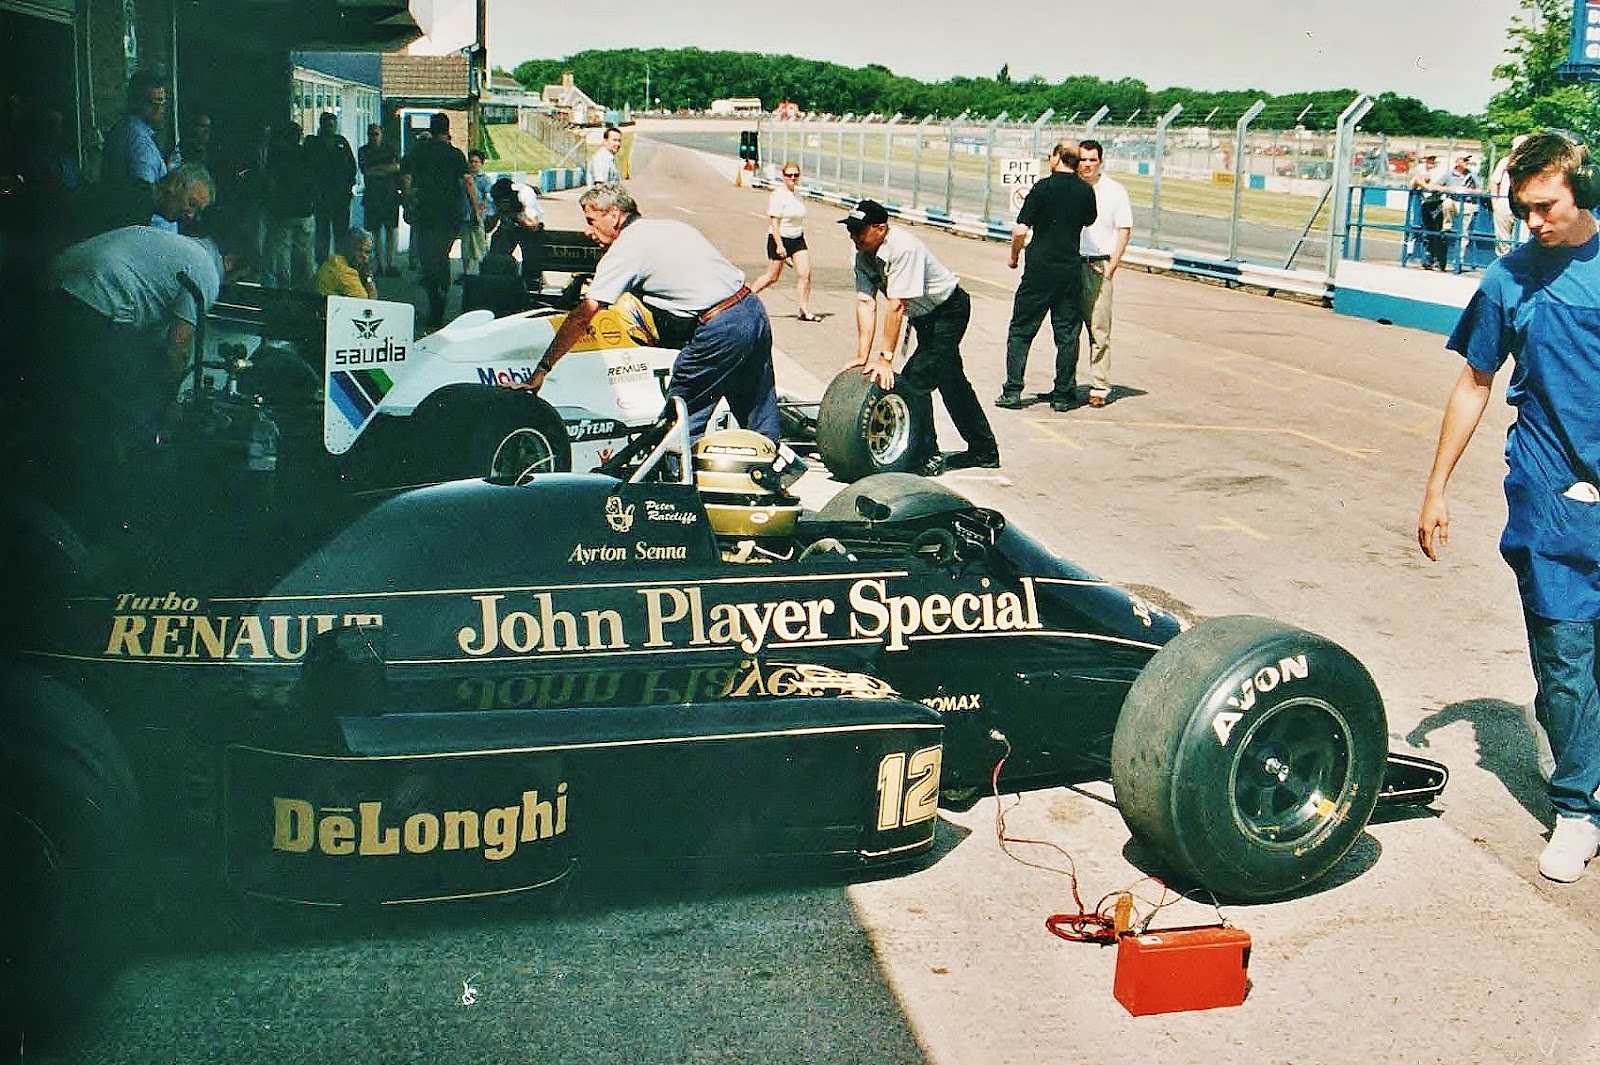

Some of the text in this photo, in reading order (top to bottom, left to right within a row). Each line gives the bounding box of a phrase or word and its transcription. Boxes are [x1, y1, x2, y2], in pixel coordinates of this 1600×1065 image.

[1009, 161, 1031, 172] PIT
[1002, 174, 1037, 184] EXIT
[335, 336, 406, 365] saudia
[607, 363, 648, 377] REMUS
[644, 500, 676, 511] Peter
[568, 541, 687, 566] Ayrton Senna
[114, 591, 200, 612] Turbo
[457, 577, 1044, 656] John Player Special
[1212, 655, 1309, 747] AVON
[877, 744, 943, 831] 12
